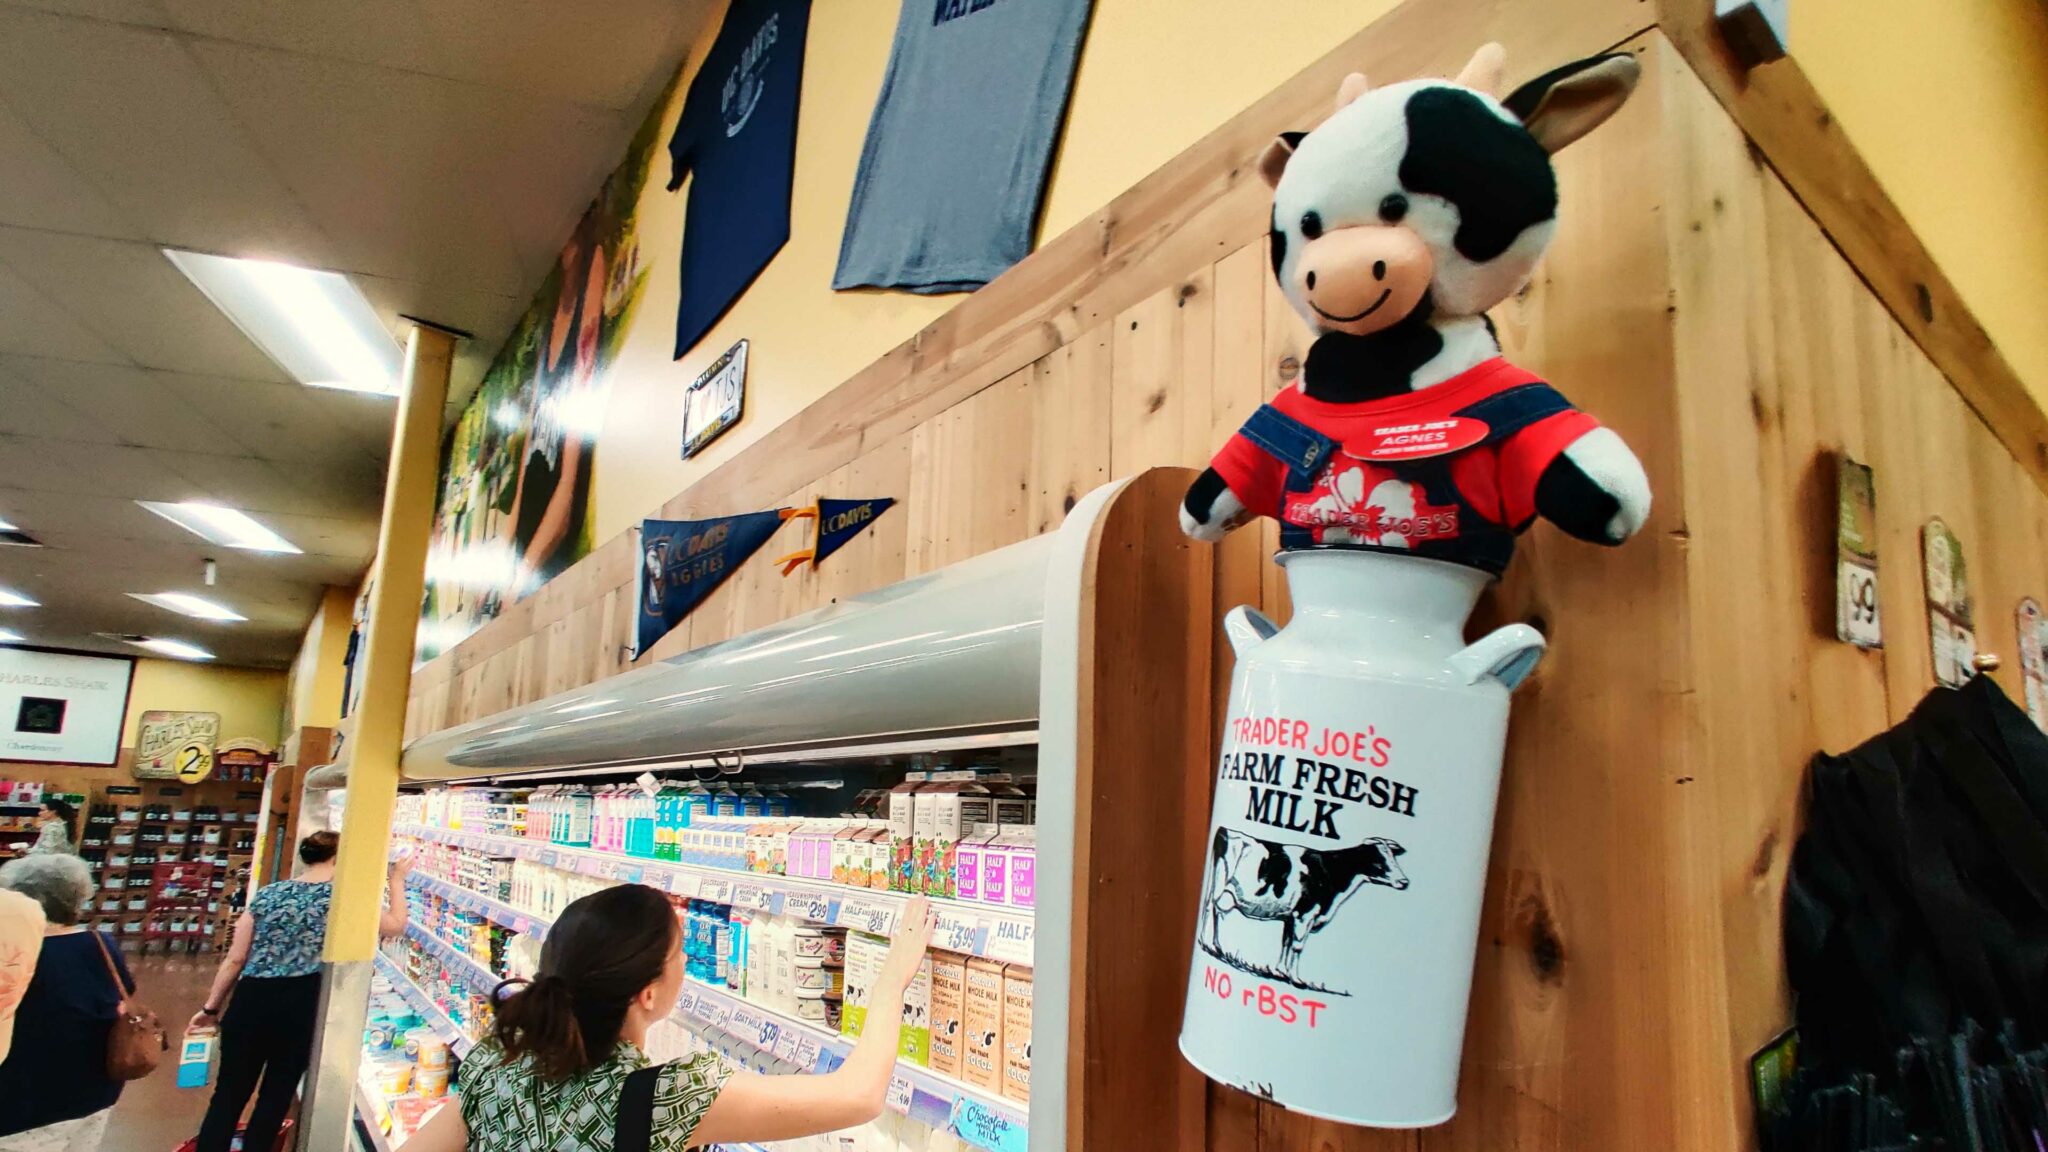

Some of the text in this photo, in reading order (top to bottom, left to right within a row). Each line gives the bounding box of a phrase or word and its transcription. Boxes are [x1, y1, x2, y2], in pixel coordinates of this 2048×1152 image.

[1374, 420, 1459, 436] TRADER JOE'S
[1380, 431, 1446, 446] AGNES
[1380, 511, 1457, 537] JOE'S
[1232, 716, 1392, 768] TRADER JOE'S
[1221, 751, 1419, 818] FARM FRESH
[1245, 785, 1345, 840] MILK
[960, 855, 976, 865] HALF
[986, 856, 1004, 868] HALF
[1014, 859, 1032, 870] HALF
[959, 879, 975, 890] HALF
[986, 882, 1002, 893] HALF
[1014, 885, 1032, 896] HALF
[788, 898, 809, 909] CREAM
[845, 905, 863, 917] HALF
[870, 910, 890, 922] HALF
[934, 917, 959, 932] HALF
[997, 921, 1031, 941] HALF
[933, 977, 960, 992] WHOLE MILK
[968, 986, 998, 1001] WHOLE MILK
[1006, 994, 1025, 1008] WHOLE
[1205, 966, 1328, 1029] NO rBST
[932, 1042, 956, 1057] COCOA
[966, 1053, 993, 1071] COCOA
[967, 1105, 1011, 1132] Chocolate
[977, 1127, 1001, 1146] MILK
